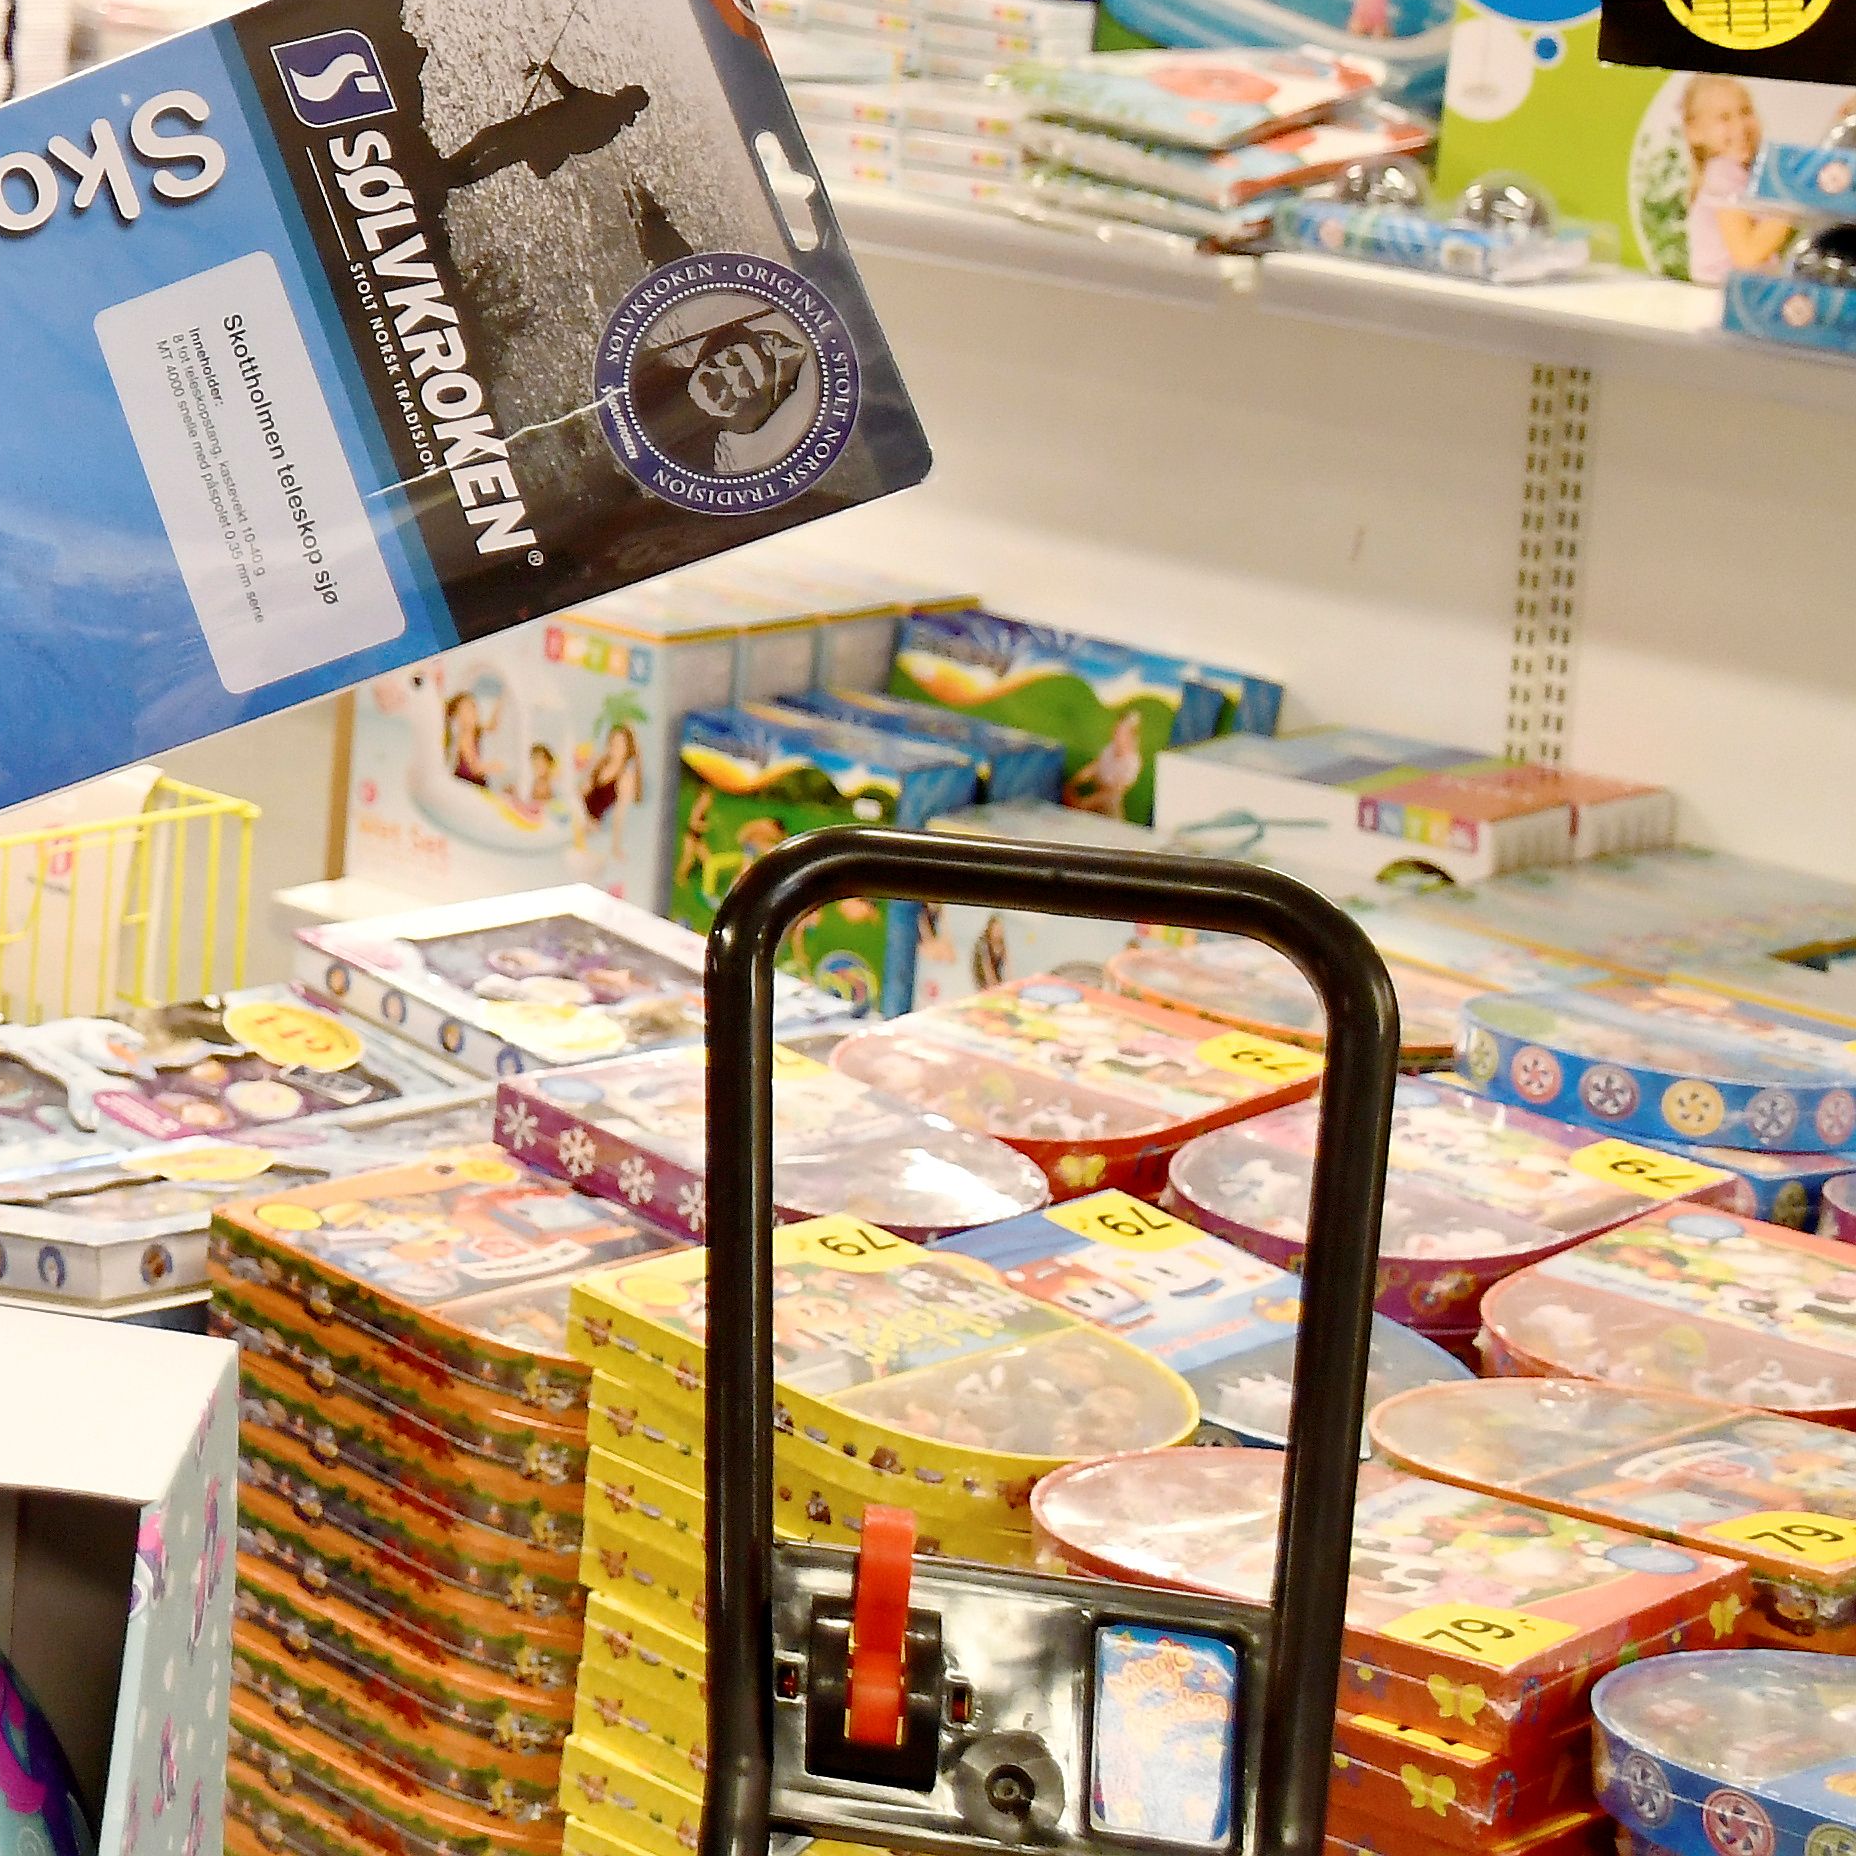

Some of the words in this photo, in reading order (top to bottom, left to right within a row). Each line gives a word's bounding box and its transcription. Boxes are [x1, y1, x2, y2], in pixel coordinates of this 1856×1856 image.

[605, 261, 715, 364] SØLVKROKEN
[736, 261, 834, 334] ORIGINAL
[155, 339, 175, 361] MT
[328, 129, 537, 556] SØLVKROKEN
[164, 364, 185, 398] 4000
[188, 326, 225, 408] Inneholder:
[348, 261, 380, 312] STOLT
[370, 315, 400, 377] NORSK
[392, 379, 436, 476] TRADISJON
[830, 351, 851, 423] STOLT
[177, 399, 198, 440] snelle
[192, 440, 210, 470] med
[223, 312, 286, 461] Skottholmen
[275, 463, 324, 566] teleskop
[313, 568, 340, 607] sjø
[781, 425, 842, 490] NORSK
[652, 467, 780, 506] TRADISJON
[1609, 1158, 1695, 1188] 79
[1097, 1205, 1173, 1237] 79
[818, 1228, 899, 1257] 79
[1747, 1523, 1845, 1553] 79
[1422, 1618, 1517, 1652] 79
